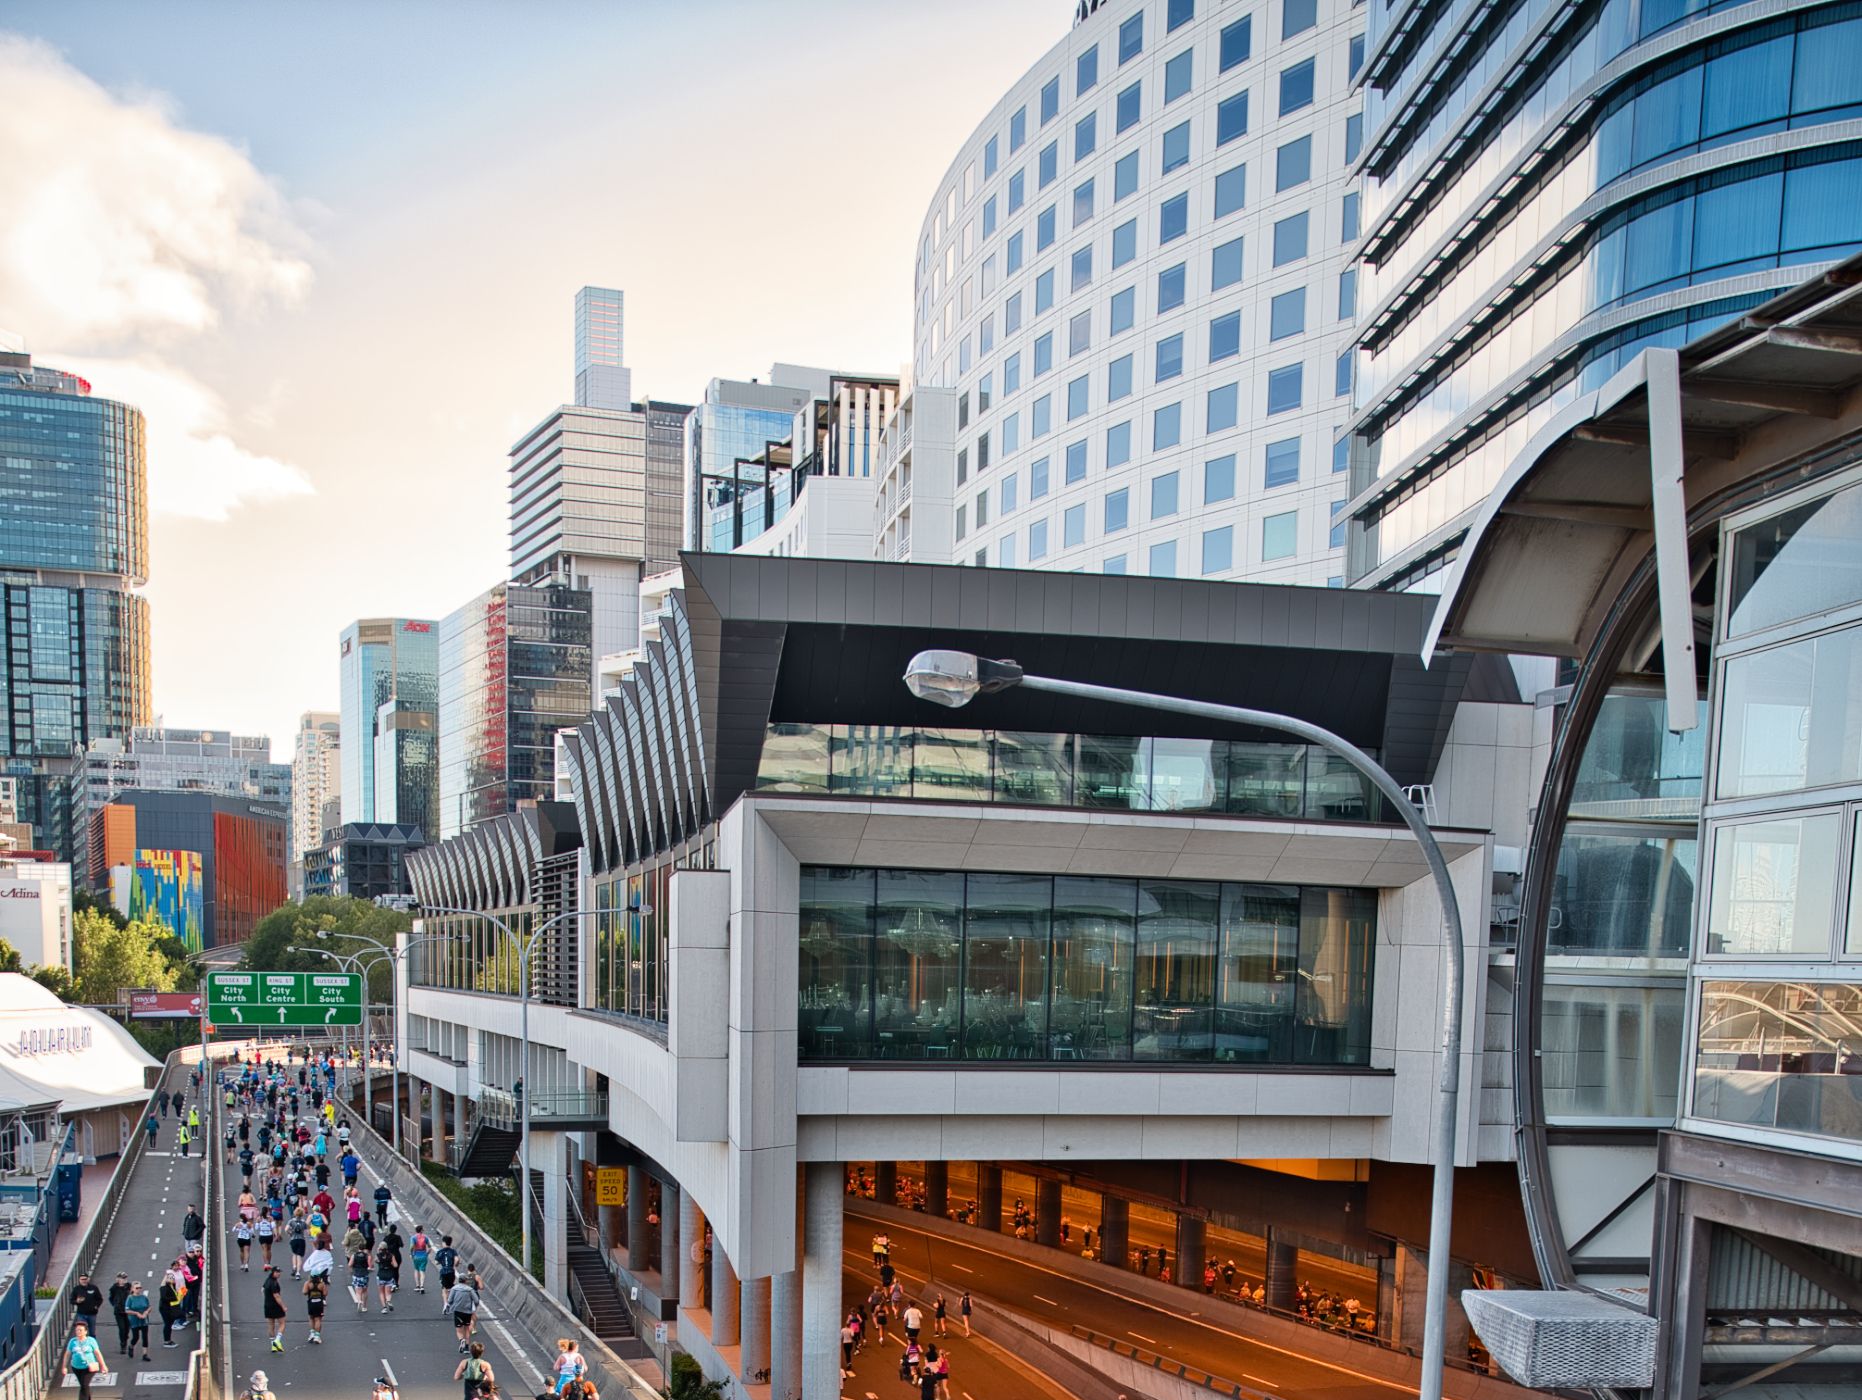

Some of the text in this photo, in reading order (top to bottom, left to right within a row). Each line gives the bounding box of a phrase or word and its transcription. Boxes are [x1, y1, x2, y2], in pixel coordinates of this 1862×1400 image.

[0, 888, 40, 899] Adina
[223, 986, 244, 995] City
[271, 987, 291, 995] City
[322, 987, 342, 996] City
[220, 994, 247, 1002] North
[265, 995, 296, 1003] Centre
[319, 995, 345, 1003] South
[20, 1026, 92, 1056] AQUARIUM
[602, 1185, 618, 1196] 50
